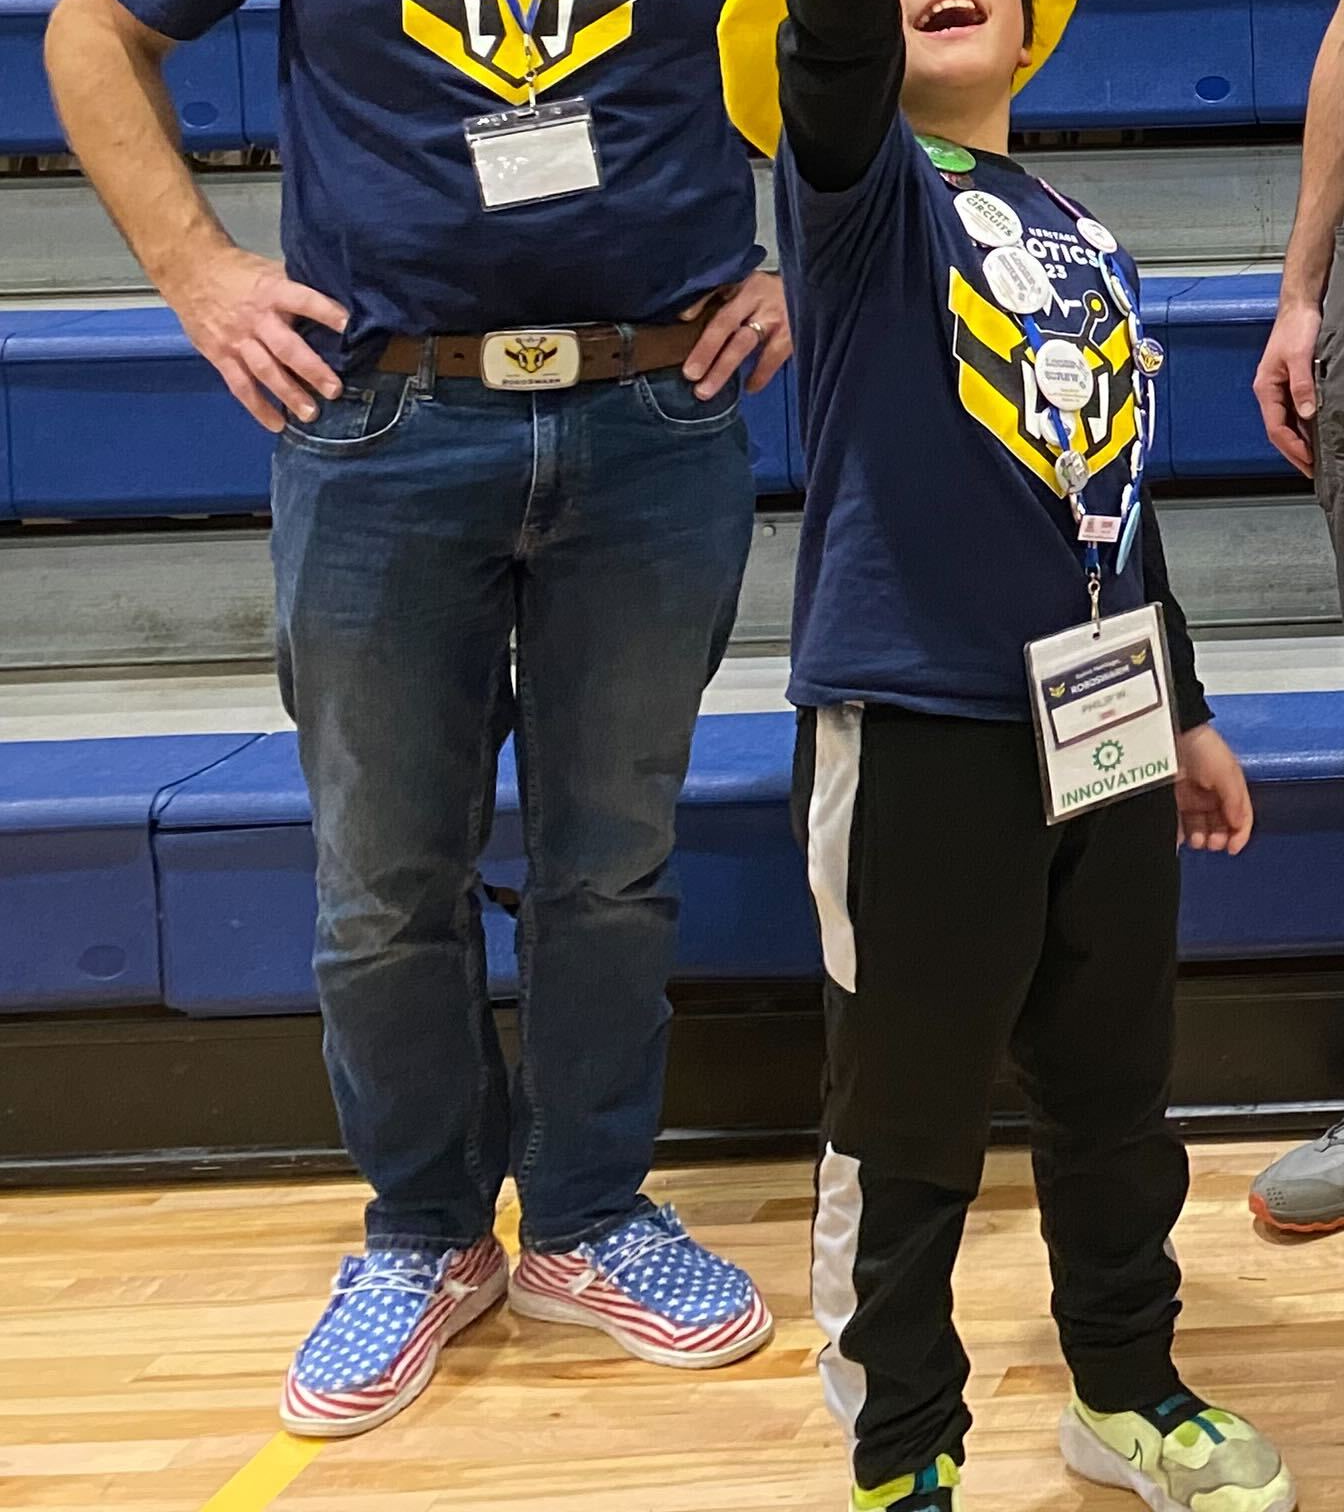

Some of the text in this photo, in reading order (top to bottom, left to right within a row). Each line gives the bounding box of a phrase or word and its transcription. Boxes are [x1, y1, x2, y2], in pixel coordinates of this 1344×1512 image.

[966, 197, 1012, 237] CIRCUITS
[973, 193, 1009, 223] SHORT
[1026, 237, 1101, 268] OTICS
[1046, 263, 1068, 279] 23
[1060, 757, 1170, 809] INNOVATION
